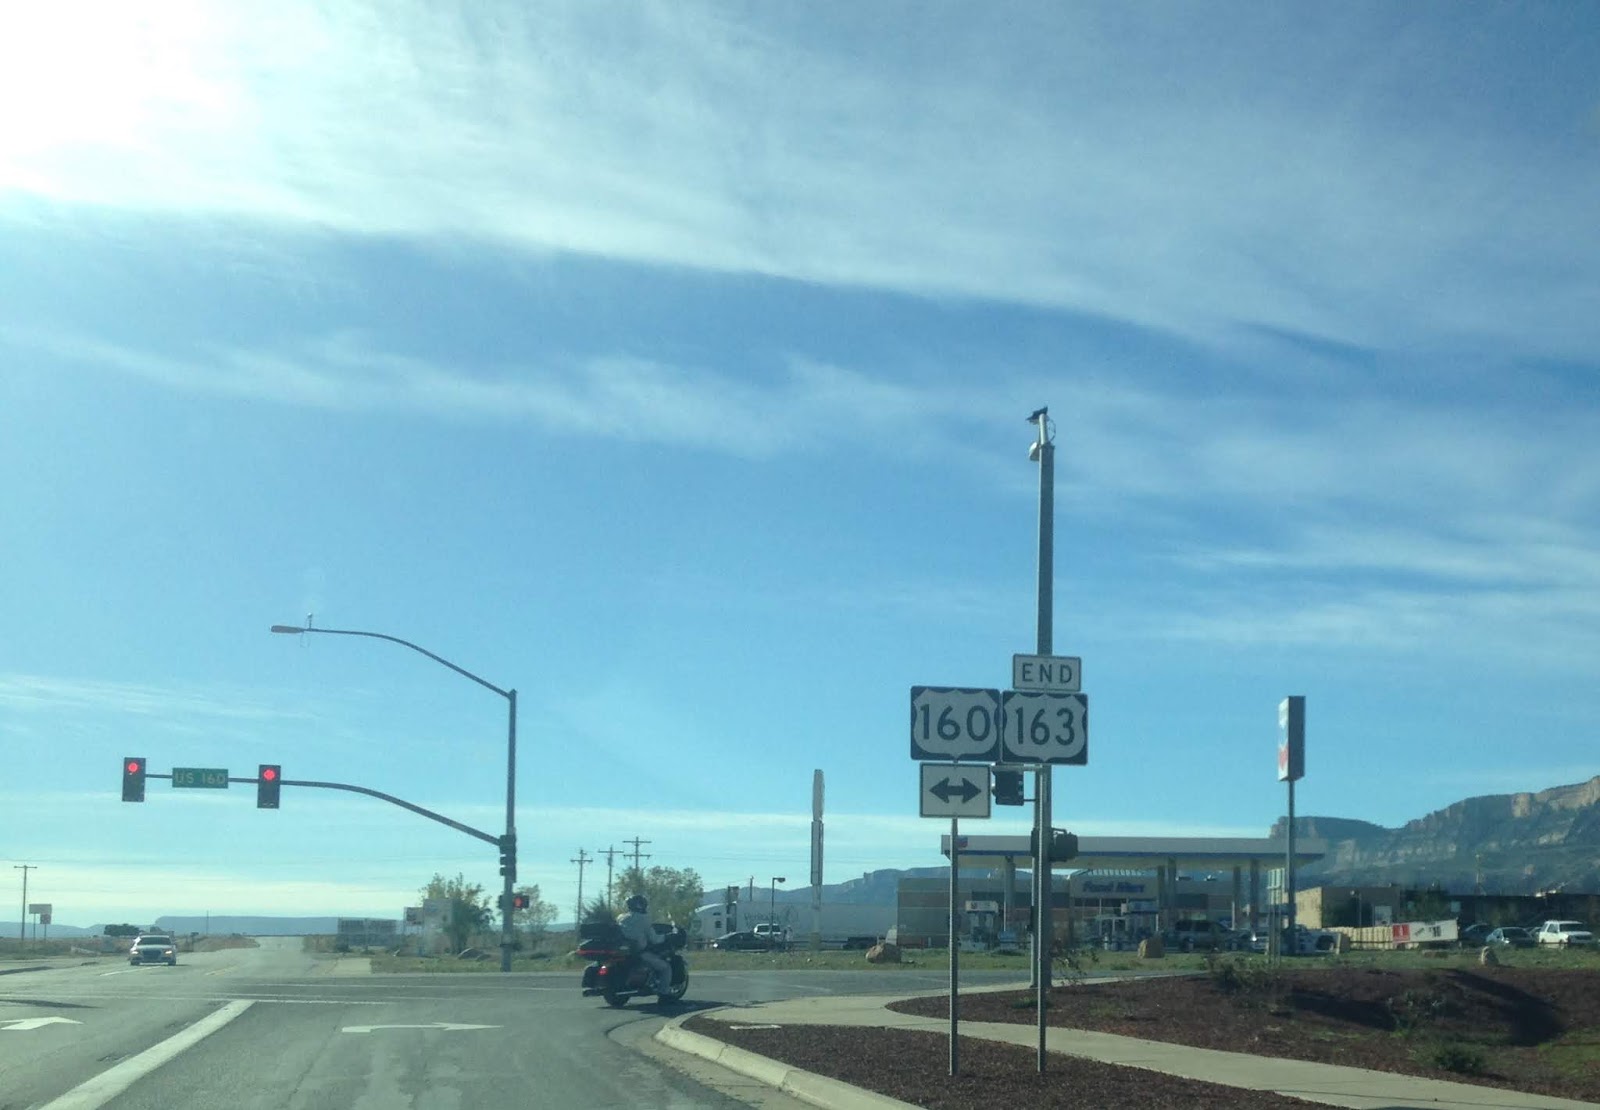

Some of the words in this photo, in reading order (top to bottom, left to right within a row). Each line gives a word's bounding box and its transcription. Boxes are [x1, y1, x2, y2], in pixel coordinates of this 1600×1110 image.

[1021, 662, 1073, 684] END
[920, 703, 991, 742] 160
[1014, 706, 1076, 746] 163
[174, 771, 195, 784] US
[202, 772, 226, 785] 160
